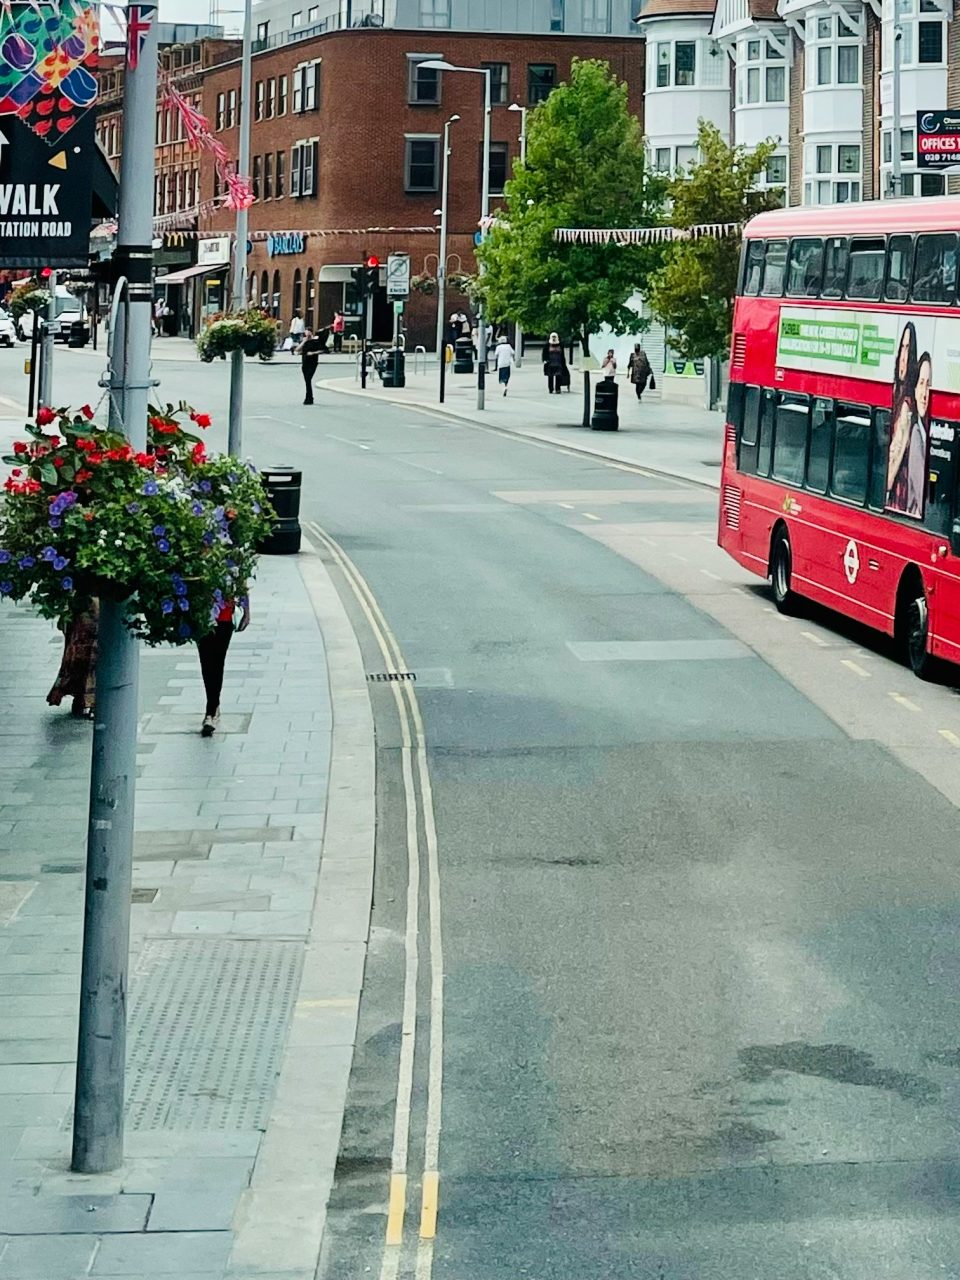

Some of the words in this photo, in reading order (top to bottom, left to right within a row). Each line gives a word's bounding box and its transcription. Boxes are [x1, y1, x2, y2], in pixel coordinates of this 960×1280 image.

[921, 138, 955, 150] OFFICES
[0, 222, 39, 237] TATION
[42, 222, 72, 237] ROAD
